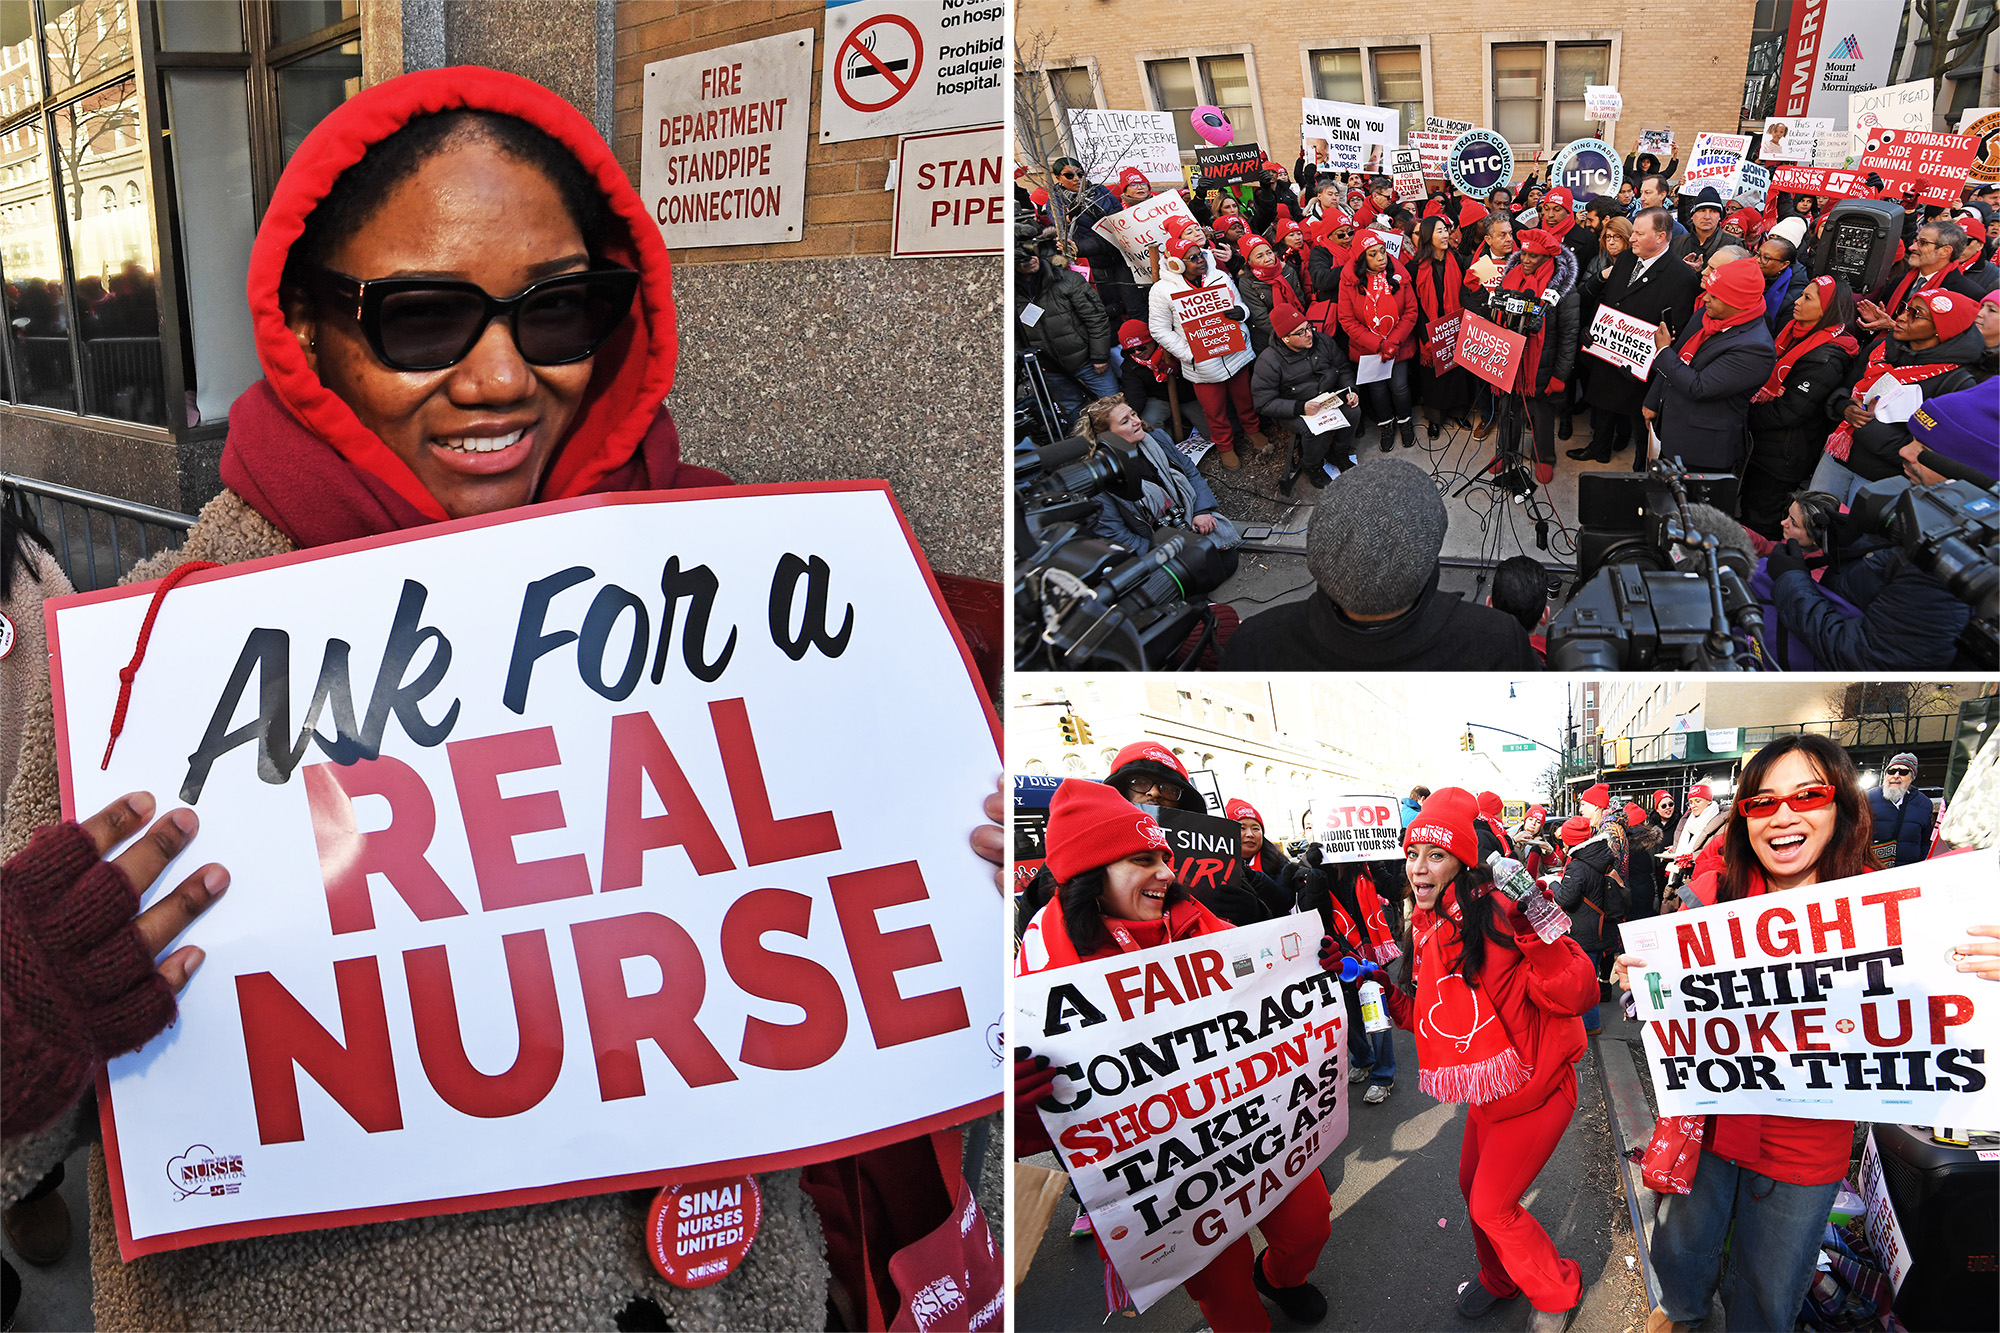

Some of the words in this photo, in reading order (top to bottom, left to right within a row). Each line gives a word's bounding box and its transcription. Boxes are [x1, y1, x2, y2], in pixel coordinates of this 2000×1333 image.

[941, 15, 960, 28] on
[938, 56, 1004, 77] cualquie
[1824, 72, 1848, 82] Sinai
[1825, 62, 1856, 72] Mount
[702, 62, 742, 100] FIRE
[937, 73, 1000, 95] hospital.
[1821, 82, 1877, 93] Morningside
[1854, 92, 1895, 113] DONT
[1898, 89, 1929, 104] TREAD
[660, 99, 787, 147] DEPARTMENT
[1306, 114, 1341, 127] SHAME
[1347, 119, 1359, 129] ON
[1366, 121, 1383, 132] YOU
[1427, 117, 1444, 127] CALL
[1904, 113, 1922, 123] ON
[1333, 130, 1359, 141] SINAI
[1454, 133, 1489, 152] TRADES
[1904, 132, 1972, 150] BOMBASTIC
[1201, 153, 1234, 163] MOUNT
[1236, 150, 1257, 159] SINAI
[1330, 144, 1361, 152] PROTECT
[1398, 154, 1410, 162] ON
[1563, 142, 1591, 160] GAMING
[1594, 143, 1616, 163] TRADES
[1723, 151, 1742, 160] THINK
[1887, 145, 1912, 158] SIDE
[1920, 149, 1943, 162] EYE
[668, 144, 771, 186] STANDPIPE
[1204, 158, 1259, 178] UNFAIR!
[1332, 161, 1360, 169] NURSES!
[1393, 162, 1419, 172] STRIKE
[1460, 155, 1502, 175] HTC
[1492, 138, 1511, 180] COUNCIL
[1697, 156, 1736, 167] NURSES
[1862, 156, 1912, 172] CRIMINAL
[1919, 163, 1969, 180] OFFENSE
[917, 156, 1002, 190] STAN
[1451, 156, 1464, 186] HOTEL
[1567, 168, 1607, 187] HTC
[1687, 165, 1735, 180] DESERVE
[1773, 170, 1824, 185] NURSES
[657, 186, 781, 225] CONNECTION
[931, 196, 1004, 227] PIPE
[1133, 201, 1179, 223] Care
[1135, 230, 1154, 244] us
[1179, 299, 1231, 321] NURSES
[1181, 291, 1220, 309] MORE
[1508, 303, 1515, 311] 12
[1517, 304, 1523, 312] 12
[1189, 323, 1236, 341] Millionaire
[1199, 317, 1221, 327] Less
[1435, 317, 1459, 334] MORE
[1599, 313, 1614, 326] We
[1615, 319, 1656, 340] Support
[1202, 333, 1230, 347] Exec$
[1467, 324, 1510, 355] NURSES
[1593, 323, 1607, 334] NY
[1610, 330, 1652, 354] NURSES
[1593, 334, 1607, 346] ON
[1610, 341, 1646, 364] STRIKE
[1463, 338, 1490, 357] Care
[1488, 352, 1508, 367] for
[1461, 351, 1478, 364] NEW
[1480, 360, 1504, 379] YORK
[180, 578, 460, 806] Ask
[503, 555, 738, 715] For
[768, 552, 855, 659] a
[1029, 775, 1057, 786] bus
[302, 697, 843, 936] REAL
[1326, 806, 1390, 828] STOP
[1177, 830, 1234, 855] SINAI
[1321, 830, 1351, 841] HIDING
[1353, 829, 1370, 839] THE
[1371, 828, 1397, 838] TRUTH
[1411, 828, 1453, 844] NURSES
[1326, 842, 1354, 853] ABOUT
[1357, 840, 1381, 851] YOUR
[1382, 839, 1395, 850] $$$
[1676, 887, 1921, 969] NIGHT
[1680, 948, 1903, 1012] SHIFT
[235, 859, 970, 1145] NURSE
[1043, 983, 1107, 1037] A
[1105, 949, 1233, 1021] FAIR
[1651, 1008, 1831, 1057] WOKE
[1860, 994, 1975, 1048] UP
[1038, 970, 1339, 1114] CONTRACT
[1660, 1055, 1785, 1093] FOR
[1790, 1048, 1986, 1092] THIS
[1060, 1016, 1342, 1168] SHOULDN'T
[1102, 1095, 1271, 1196] TAKE
[1287, 1055, 1338, 1111] AS
[181, 1160, 243, 1180] NURSES
[1132, 1124, 1286, 1237] LONG
[1290, 1088, 1337, 1143] AS
[183, 1170, 246, 1185] ASSOCIATION
[678, 1184, 741, 1218] SINAI
[656, 1205, 669, 1243] HOSPITAL
[678, 1209, 743, 1237] NURSES
[1869, 1197, 1889, 1245] BETTER
[677, 1227, 743, 1256] UNITED!
